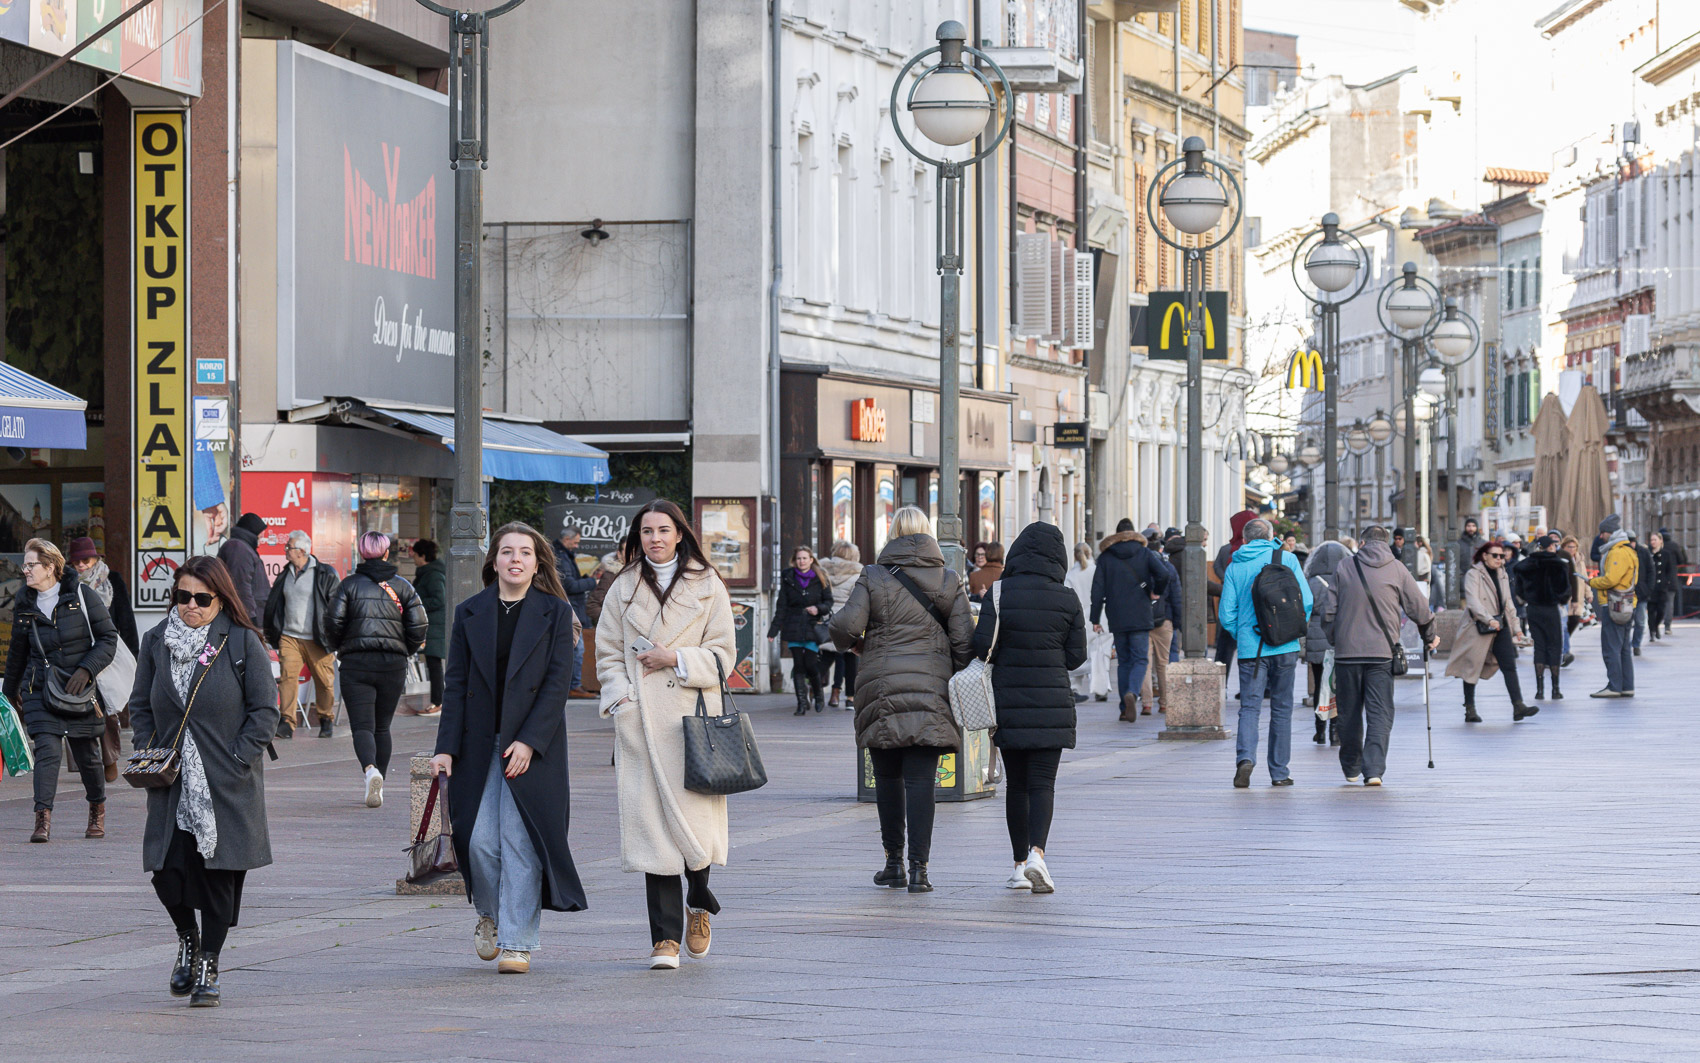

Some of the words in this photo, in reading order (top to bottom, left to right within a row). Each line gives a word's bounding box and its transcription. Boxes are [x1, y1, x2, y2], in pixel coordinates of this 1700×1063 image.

[141, 122, 179, 320] OTKUP
[373, 296, 398, 347] Dress
[396, 303, 412, 363] for
[414, 308, 428, 352] the
[200, 362, 222, 370] KORZO
[207, 372, 216, 380] 15
[2, 415, 25, 439] GELATO
[141, 341, 182, 539] ZLATA
[196, 441, 205, 452] 2.
[207, 441, 226, 452] KAT
[281, 478, 305, 509] A1
[140, 588, 172, 602] ULA
